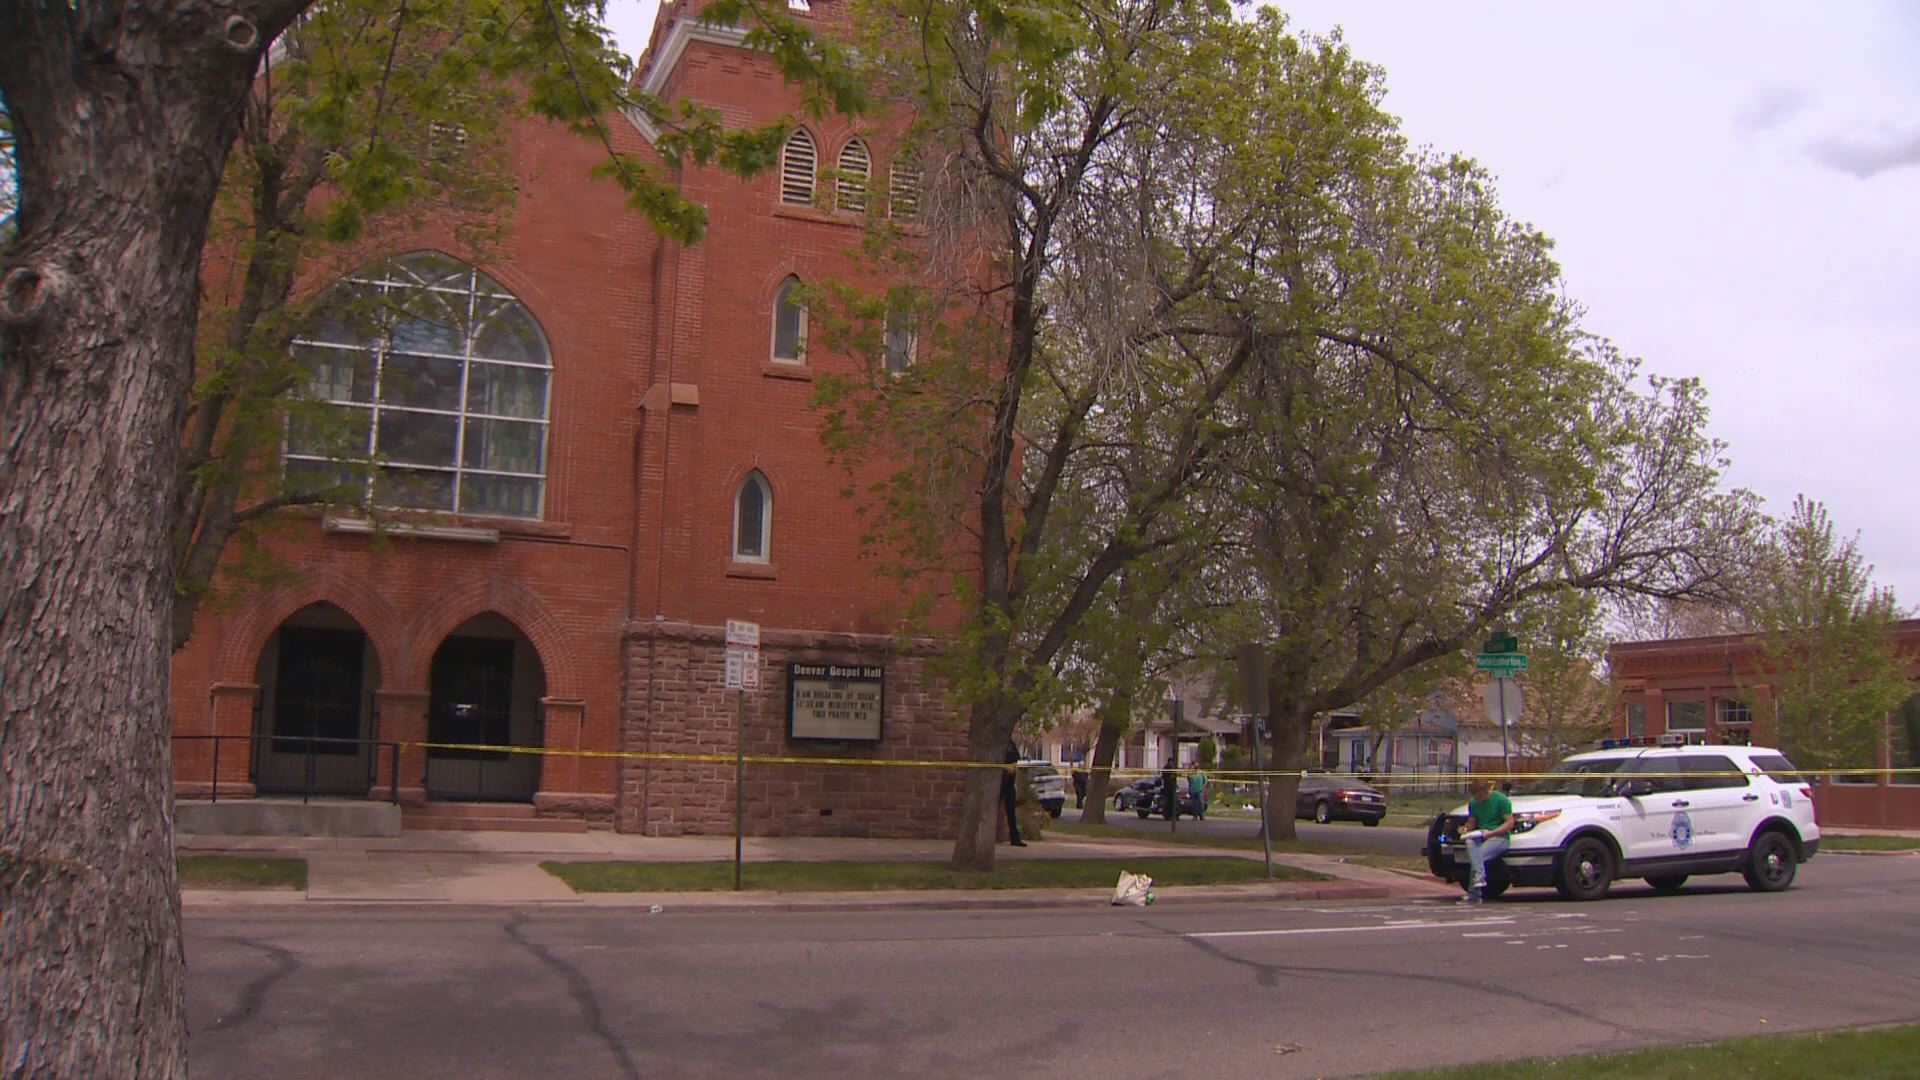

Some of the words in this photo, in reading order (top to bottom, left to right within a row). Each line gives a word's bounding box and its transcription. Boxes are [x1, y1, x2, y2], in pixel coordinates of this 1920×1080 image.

[793, 664, 826, 676] Denver
[829, 665, 860, 679] Gospel
[863, 666, 881, 679] Hall
[828, 701, 858, 709] MINISTRY
[828, 710, 850, 719] PRAYER
